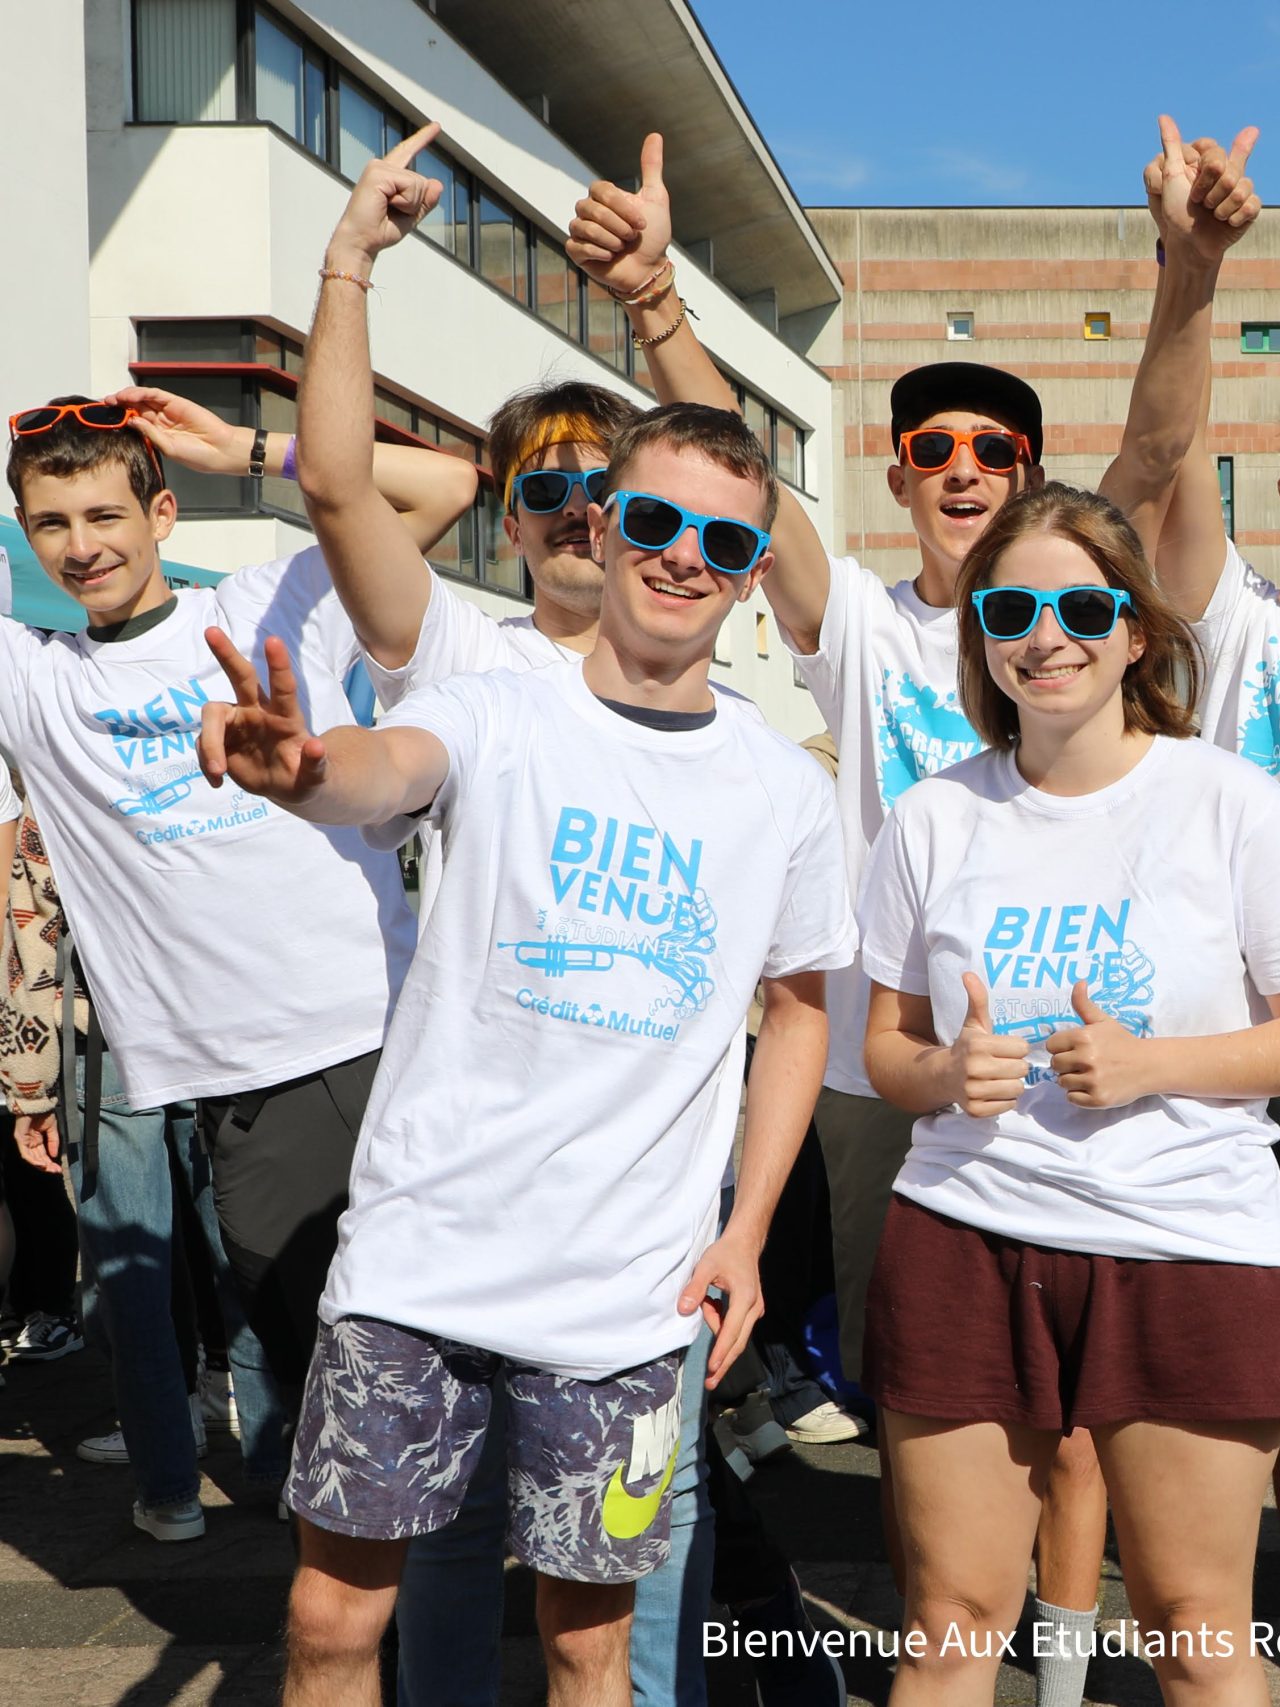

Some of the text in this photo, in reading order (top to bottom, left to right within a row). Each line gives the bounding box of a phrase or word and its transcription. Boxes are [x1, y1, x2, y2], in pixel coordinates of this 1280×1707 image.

[112, 729, 198, 769] VEN
[900, 721, 976, 763] CRAZY
[136, 803, 268, 846] Crédit Mutuel
[550, 806, 703, 894] BIEN
[549, 864, 694, 932] VENUE
[537, 909, 548, 932] AUX
[984, 898, 1131, 953] BIEN
[983, 951, 1123, 991] VENUE
[516, 988, 680, 1042] Crédit Mutuel
